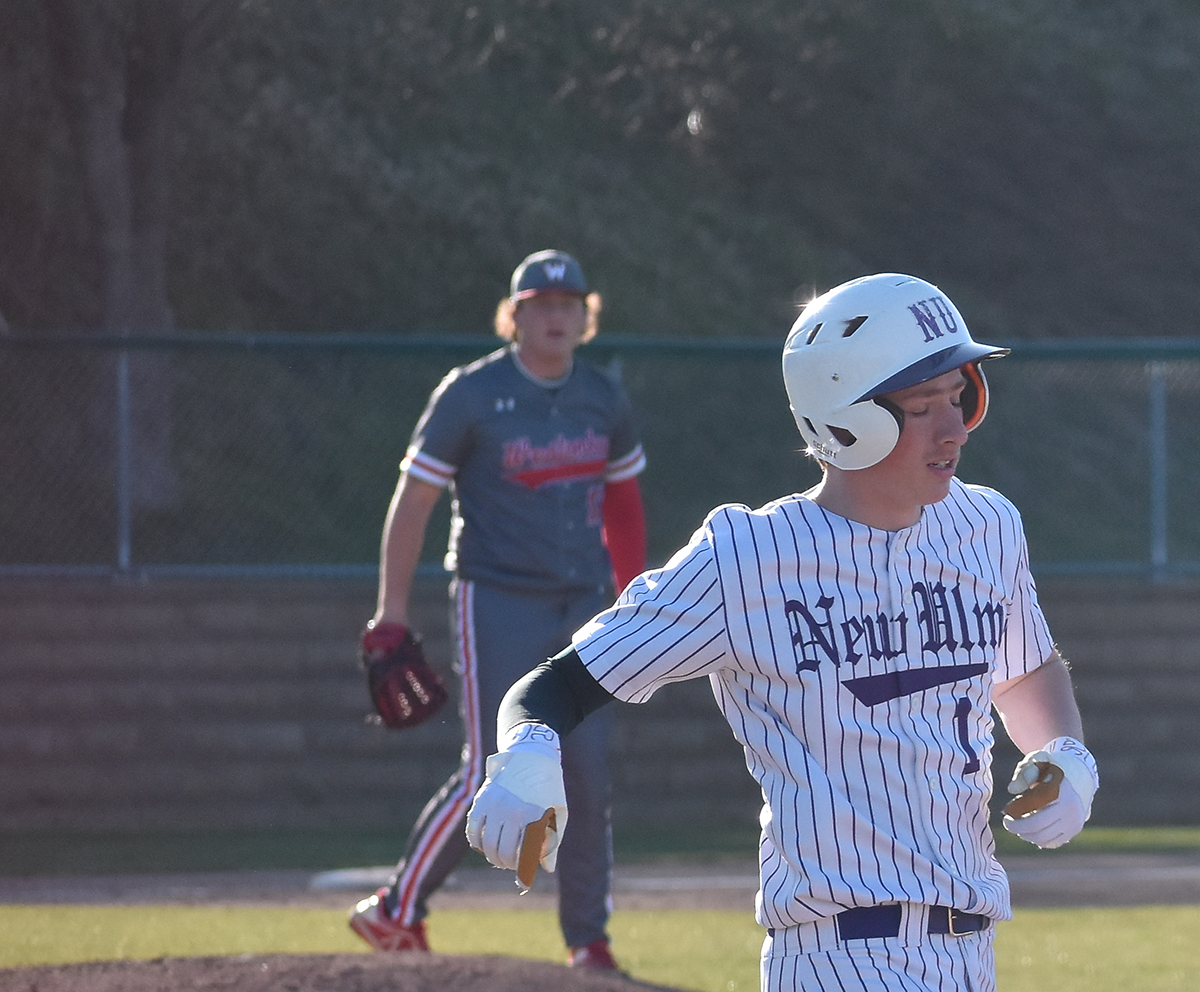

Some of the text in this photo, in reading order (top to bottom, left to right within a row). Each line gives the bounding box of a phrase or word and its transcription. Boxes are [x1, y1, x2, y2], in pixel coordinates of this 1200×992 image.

[543, 262, 567, 282] W
[907, 296, 958, 343] NU
[784, 580, 1004, 675] New Ulm
[953, 697, 981, 775] 1
